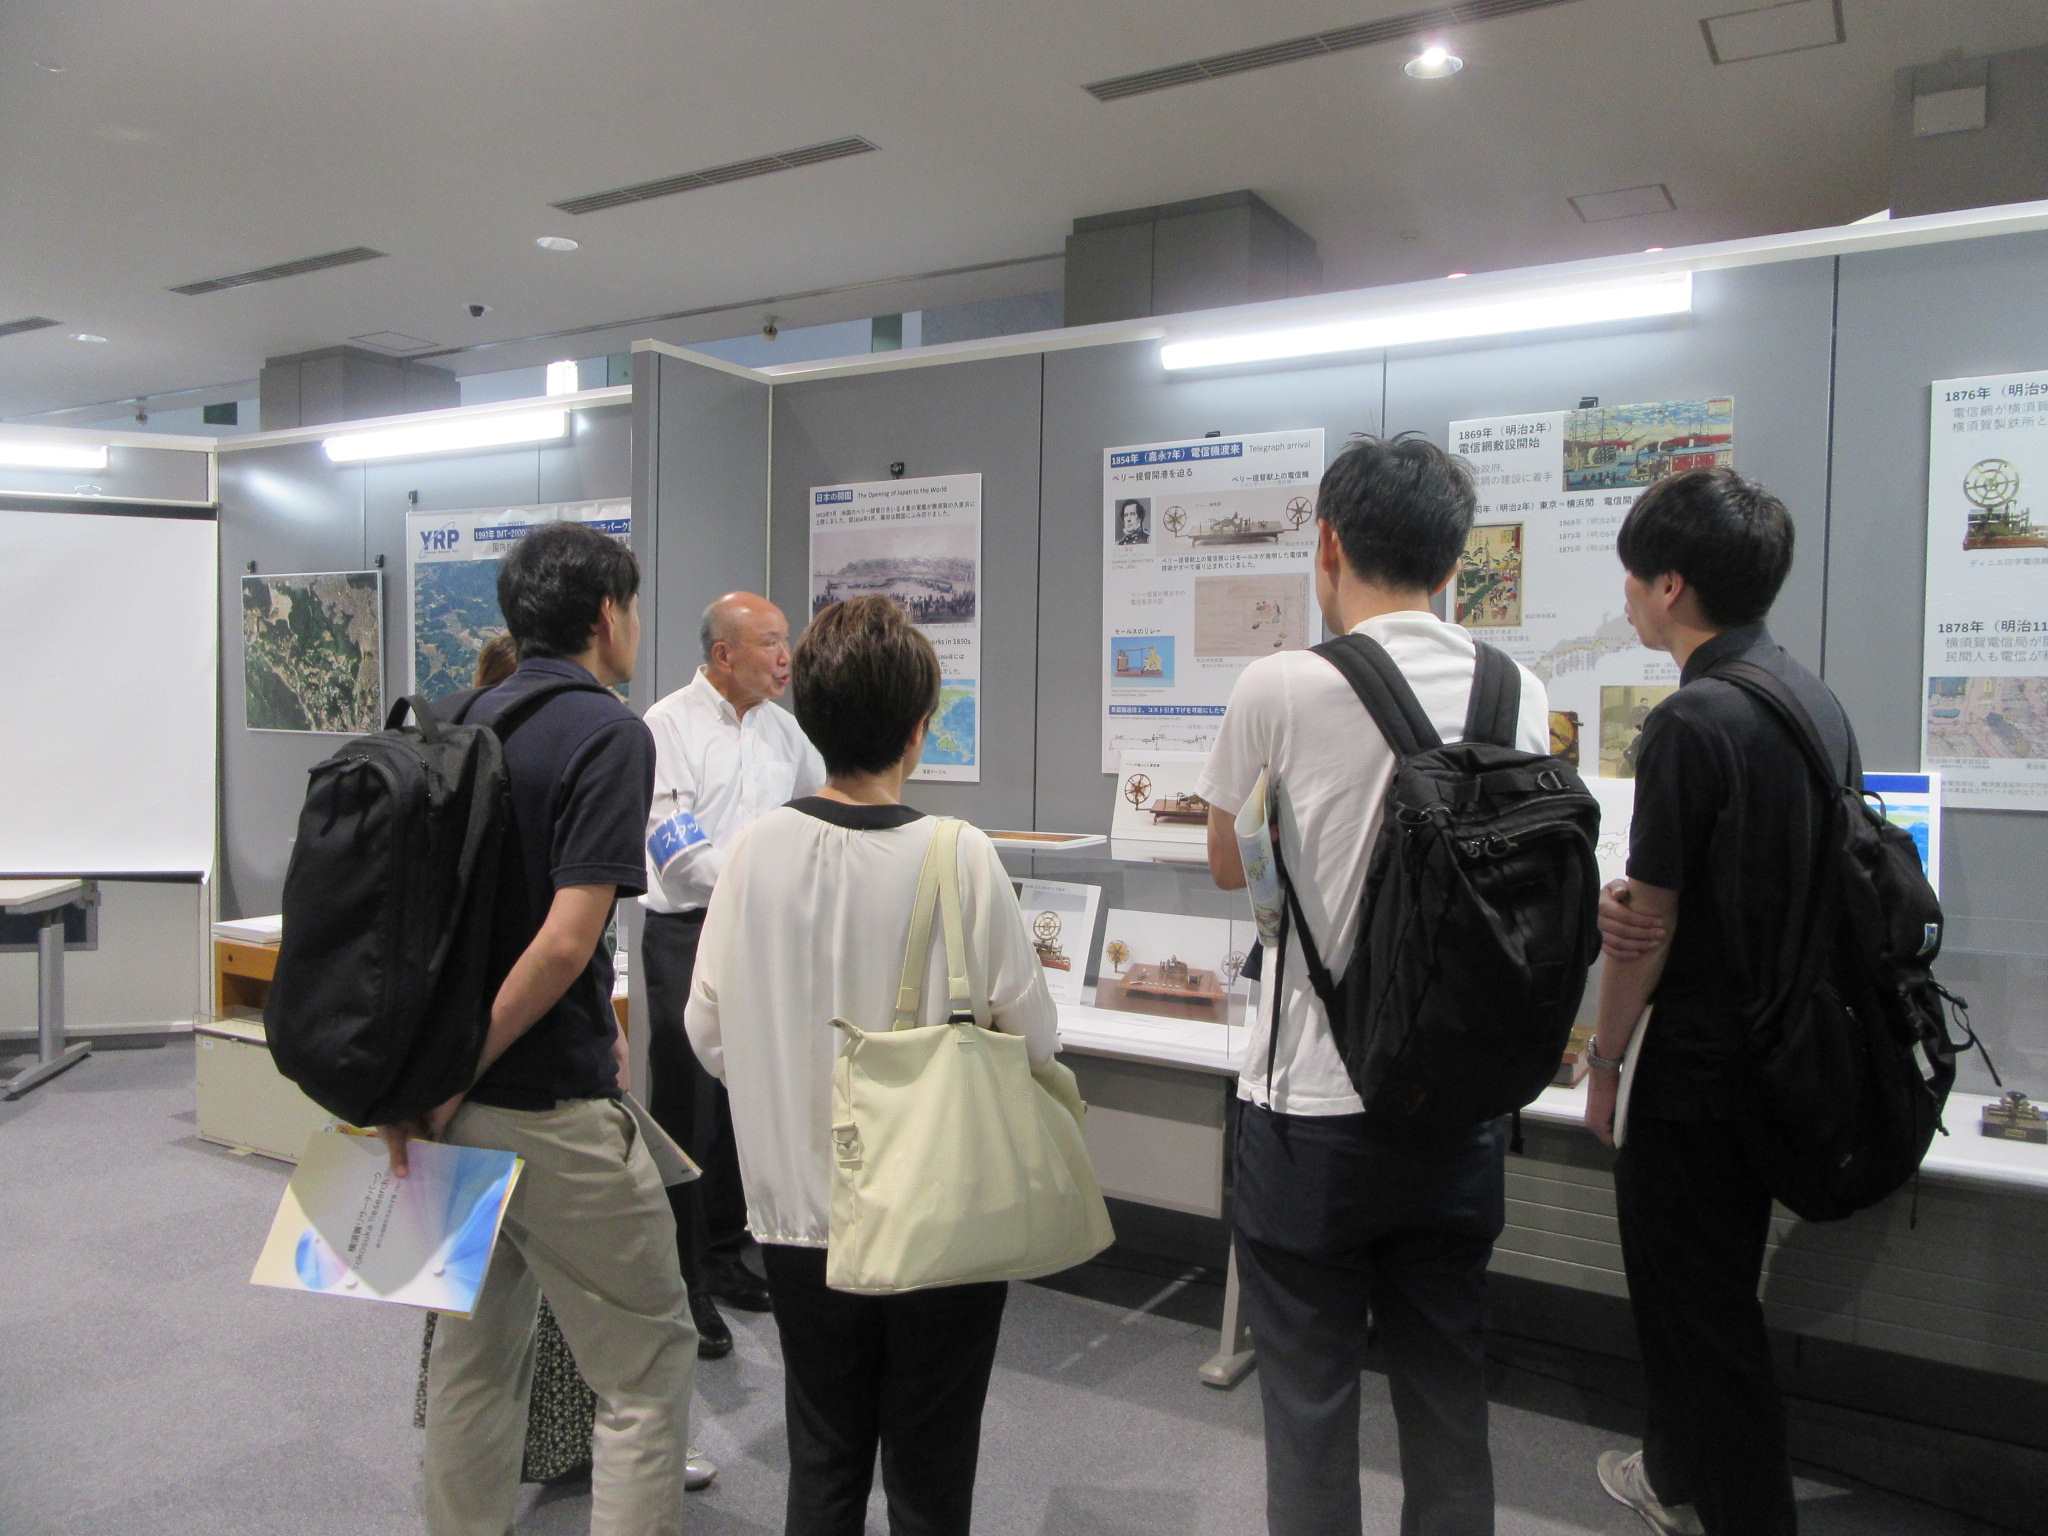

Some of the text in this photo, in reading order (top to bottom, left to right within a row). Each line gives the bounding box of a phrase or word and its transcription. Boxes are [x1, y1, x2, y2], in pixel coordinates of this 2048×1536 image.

[1459, 423, 1552, 439] 1869年（明治2年）
[1249, 440, 1311, 455] Telegraph arrival
[1459, 439, 1540, 454] 電信網敷設開始
[420, 529, 460, 550] YRP
